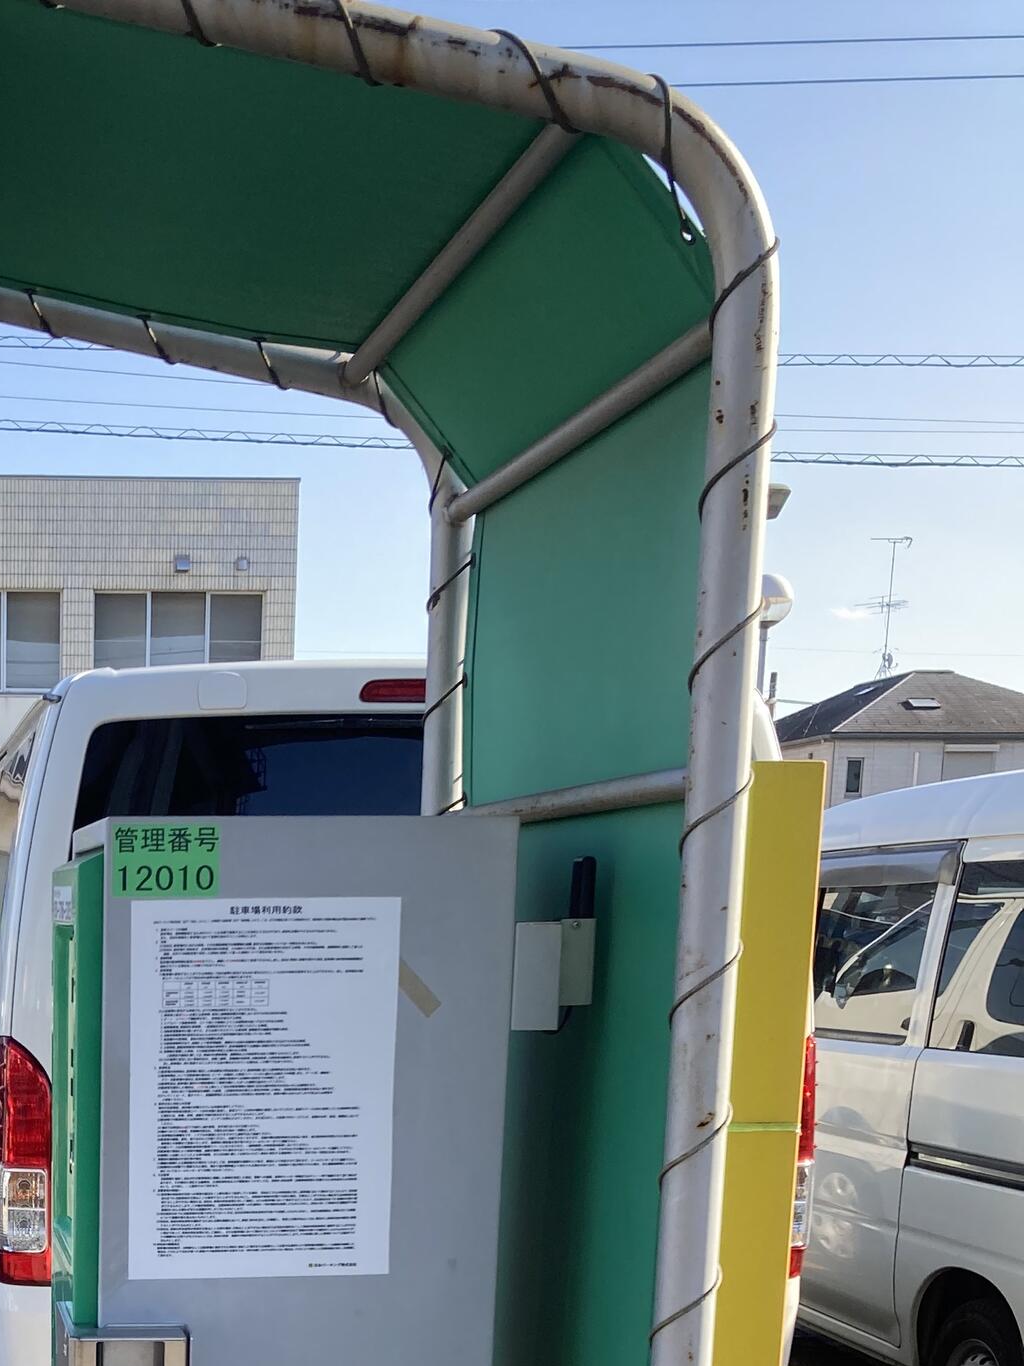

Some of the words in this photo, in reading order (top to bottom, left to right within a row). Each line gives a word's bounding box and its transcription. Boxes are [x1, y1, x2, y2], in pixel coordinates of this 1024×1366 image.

[115, 827, 219, 853] 管理番号
[118, 865, 214, 891] 12010
